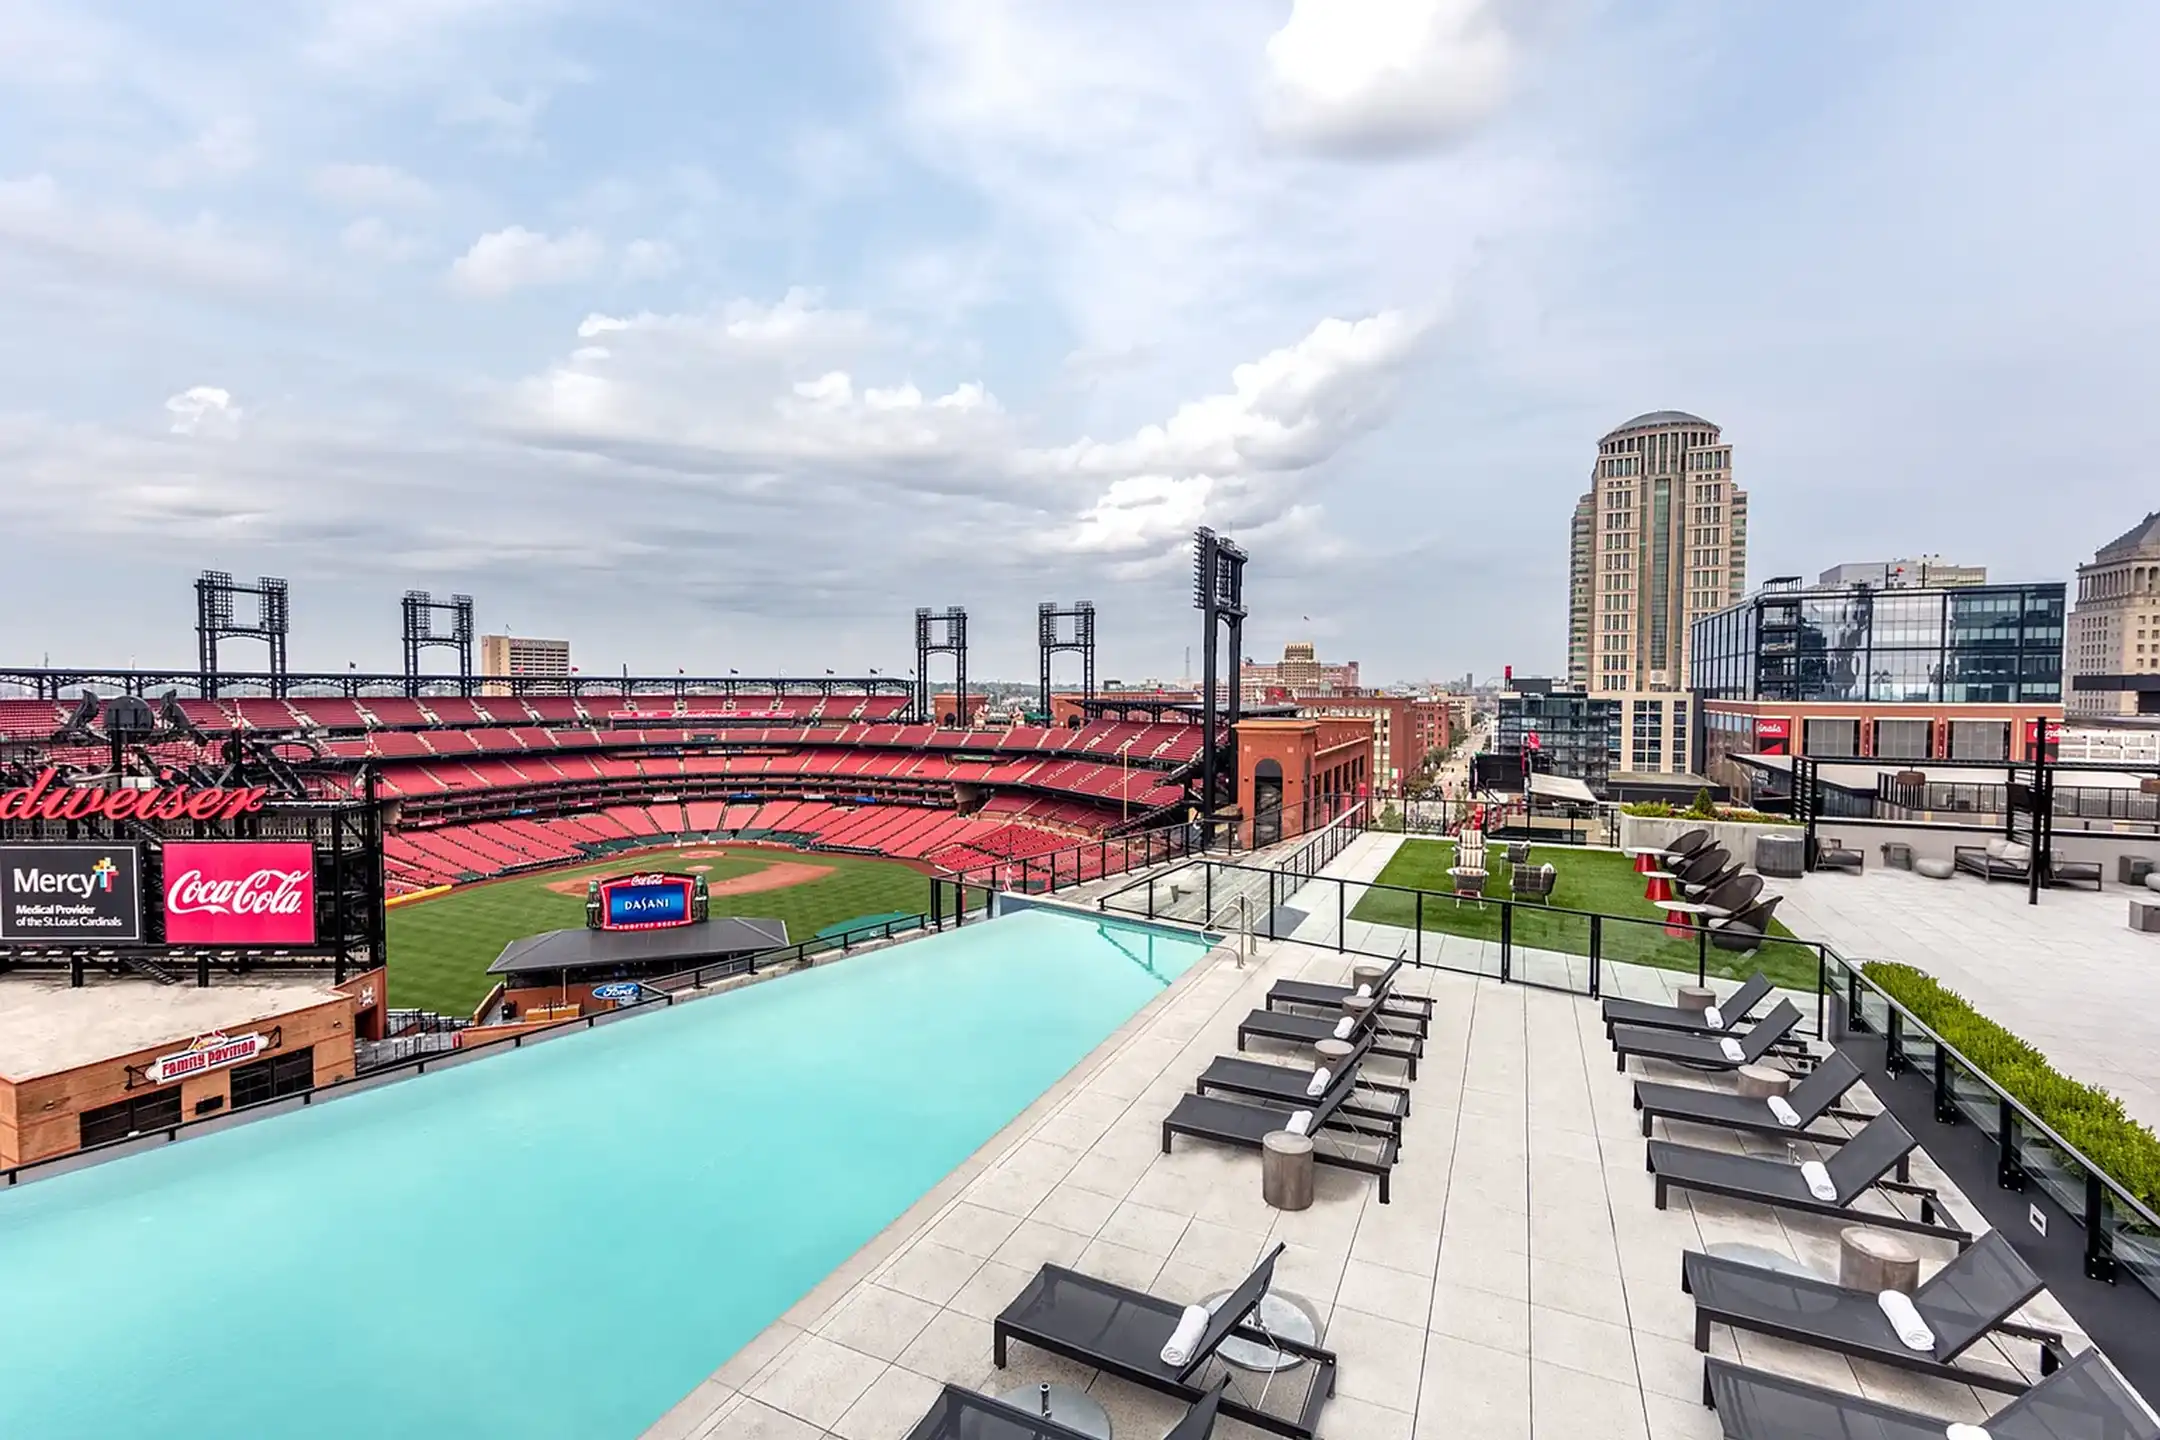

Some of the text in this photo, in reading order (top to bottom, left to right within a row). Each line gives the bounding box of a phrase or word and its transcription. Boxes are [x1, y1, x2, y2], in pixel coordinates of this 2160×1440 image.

[13, 868, 98, 899] Mercy
[167, 869, 311, 915] Coca-Cola
[15, 904, 97, 915] Medical Provider
[624, 897, 669, 911] DASANI
[15, 916, 26, 927] of
[27, 916, 43, 927] the
[55, 916, 80, 927] Louis
[80, 916, 123, 927] Cardinals
[602, 985, 635, 998] Ford
